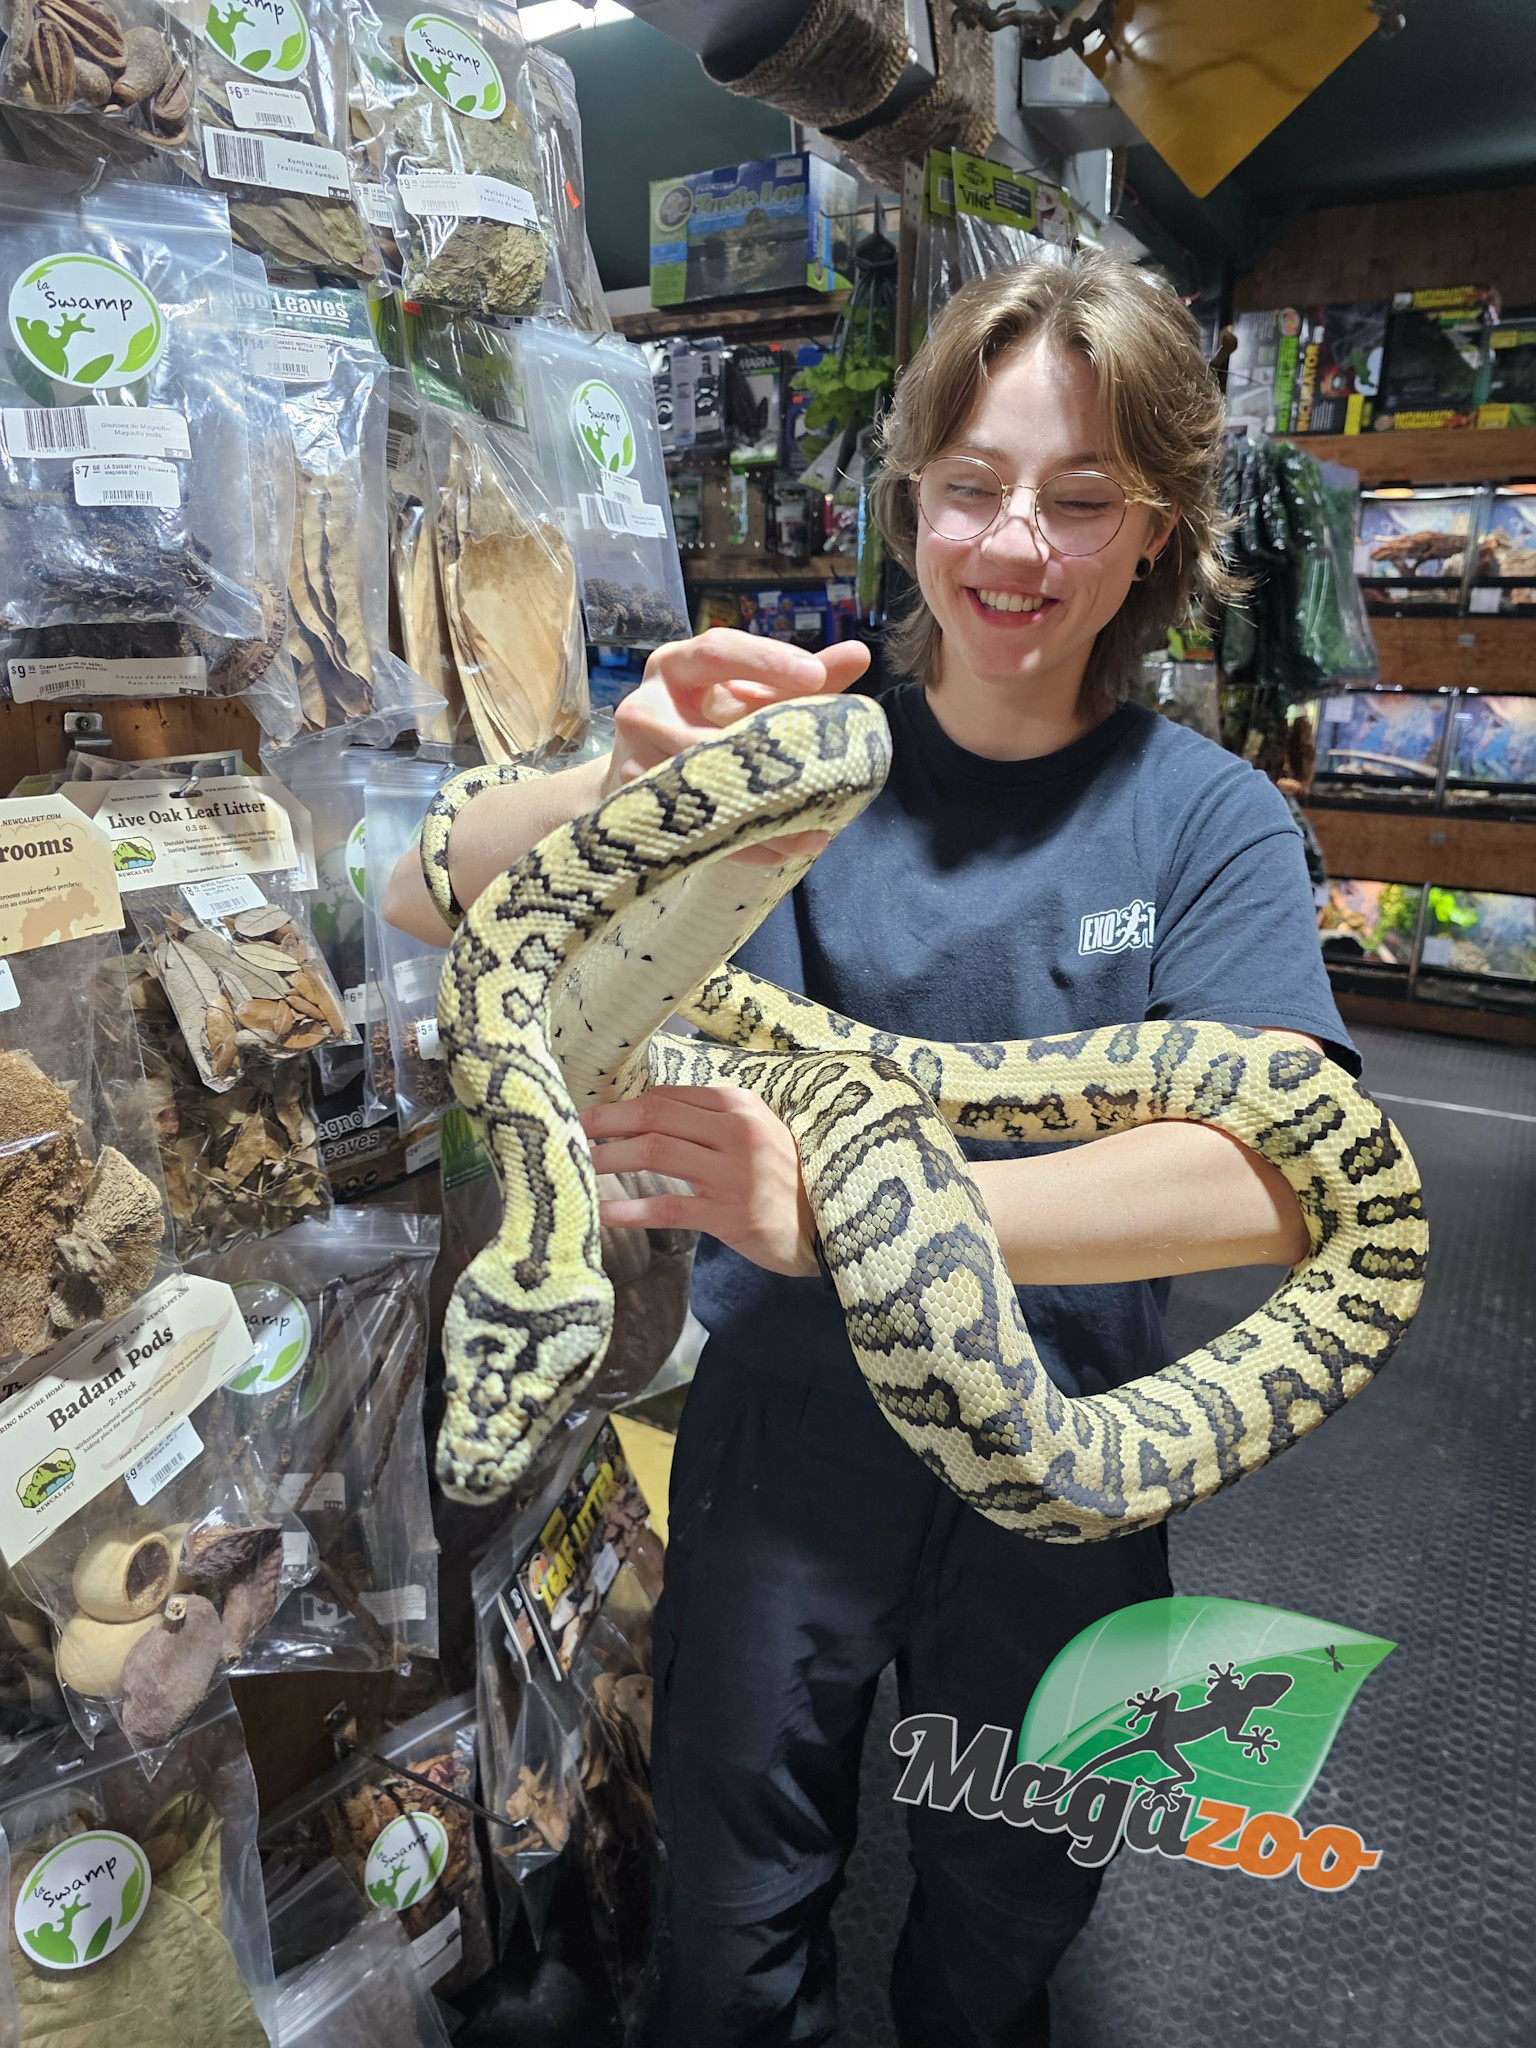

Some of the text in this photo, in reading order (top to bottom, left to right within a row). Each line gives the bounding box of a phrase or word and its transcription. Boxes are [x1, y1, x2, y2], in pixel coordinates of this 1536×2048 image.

[419, 28, 428, 38] la
[425, 38, 481, 76] Swamp
[37, 280, 50, 291] la
[44, 290, 133, 321] Swamp
[273, 292, 349, 318] Leaves
[587, 405, 621, 430] Swamp
[75, 465, 90, 478] $7
[11, 665, 26, 678] $9
[107, 801, 266, 830] Live Oak Leaf Litter
[0, 836, 74, 863] rooms
[163, 839, 184, 847] Durable
[142, 867, 154, 875] PET
[21, 888, 37, 897] make
[38, 885, 57, 896] perfect
[1083, 913, 1116, 951] EXO
[323, 1130, 380, 1161] eaves
[243, 1314, 290, 1336] amp
[46, 1327, 174, 1433] Badam Pods
[108, 1381, 137, 1406] 2-Pack
[17, 1397, 45, 1421] NATURE
[74, 1427, 103, 1451] Withstands
[103, 1413, 121, 1429] natural
[83, 1440, 101, 1454] hiding
[101, 1428, 113, 1442] place
[113, 1421, 121, 1430] for
[121, 1409, 135, 1423] small
[126, 1468, 137, 1481] $9
[36, 1481, 76, 1515] NEWCAL PET
[541, 1533, 578, 1614] LEAF
[381, 1832, 429, 1868] Swamp
[34, 1886, 45, 1897] la
[43, 1857, 117, 1908] Swamp
